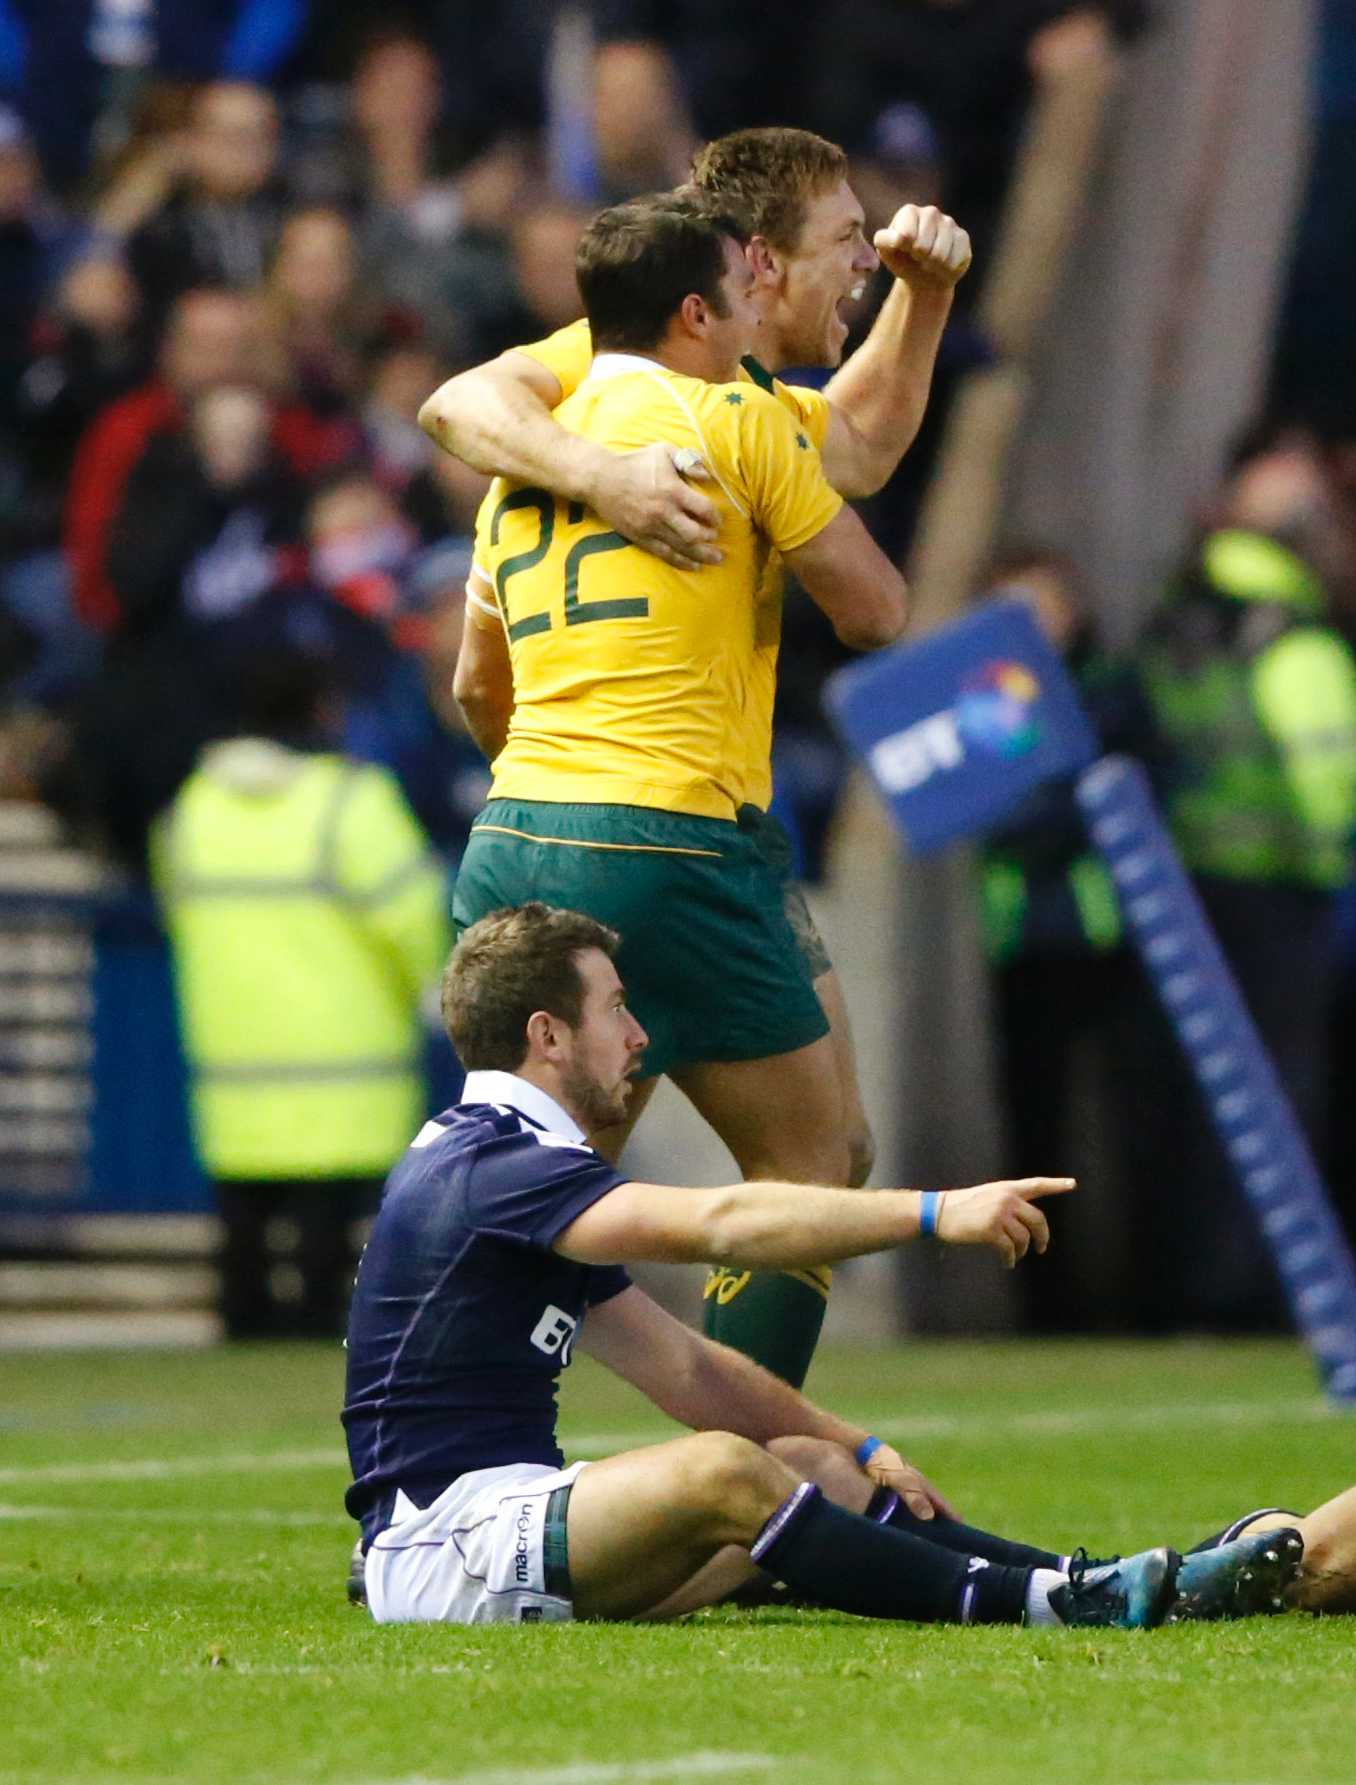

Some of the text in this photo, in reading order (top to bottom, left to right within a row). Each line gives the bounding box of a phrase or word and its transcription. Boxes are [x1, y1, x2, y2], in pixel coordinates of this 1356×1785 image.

[491, 486, 649, 644] 22
[868, 708, 966, 795] BT
[514, 1503, 533, 1582] macron
